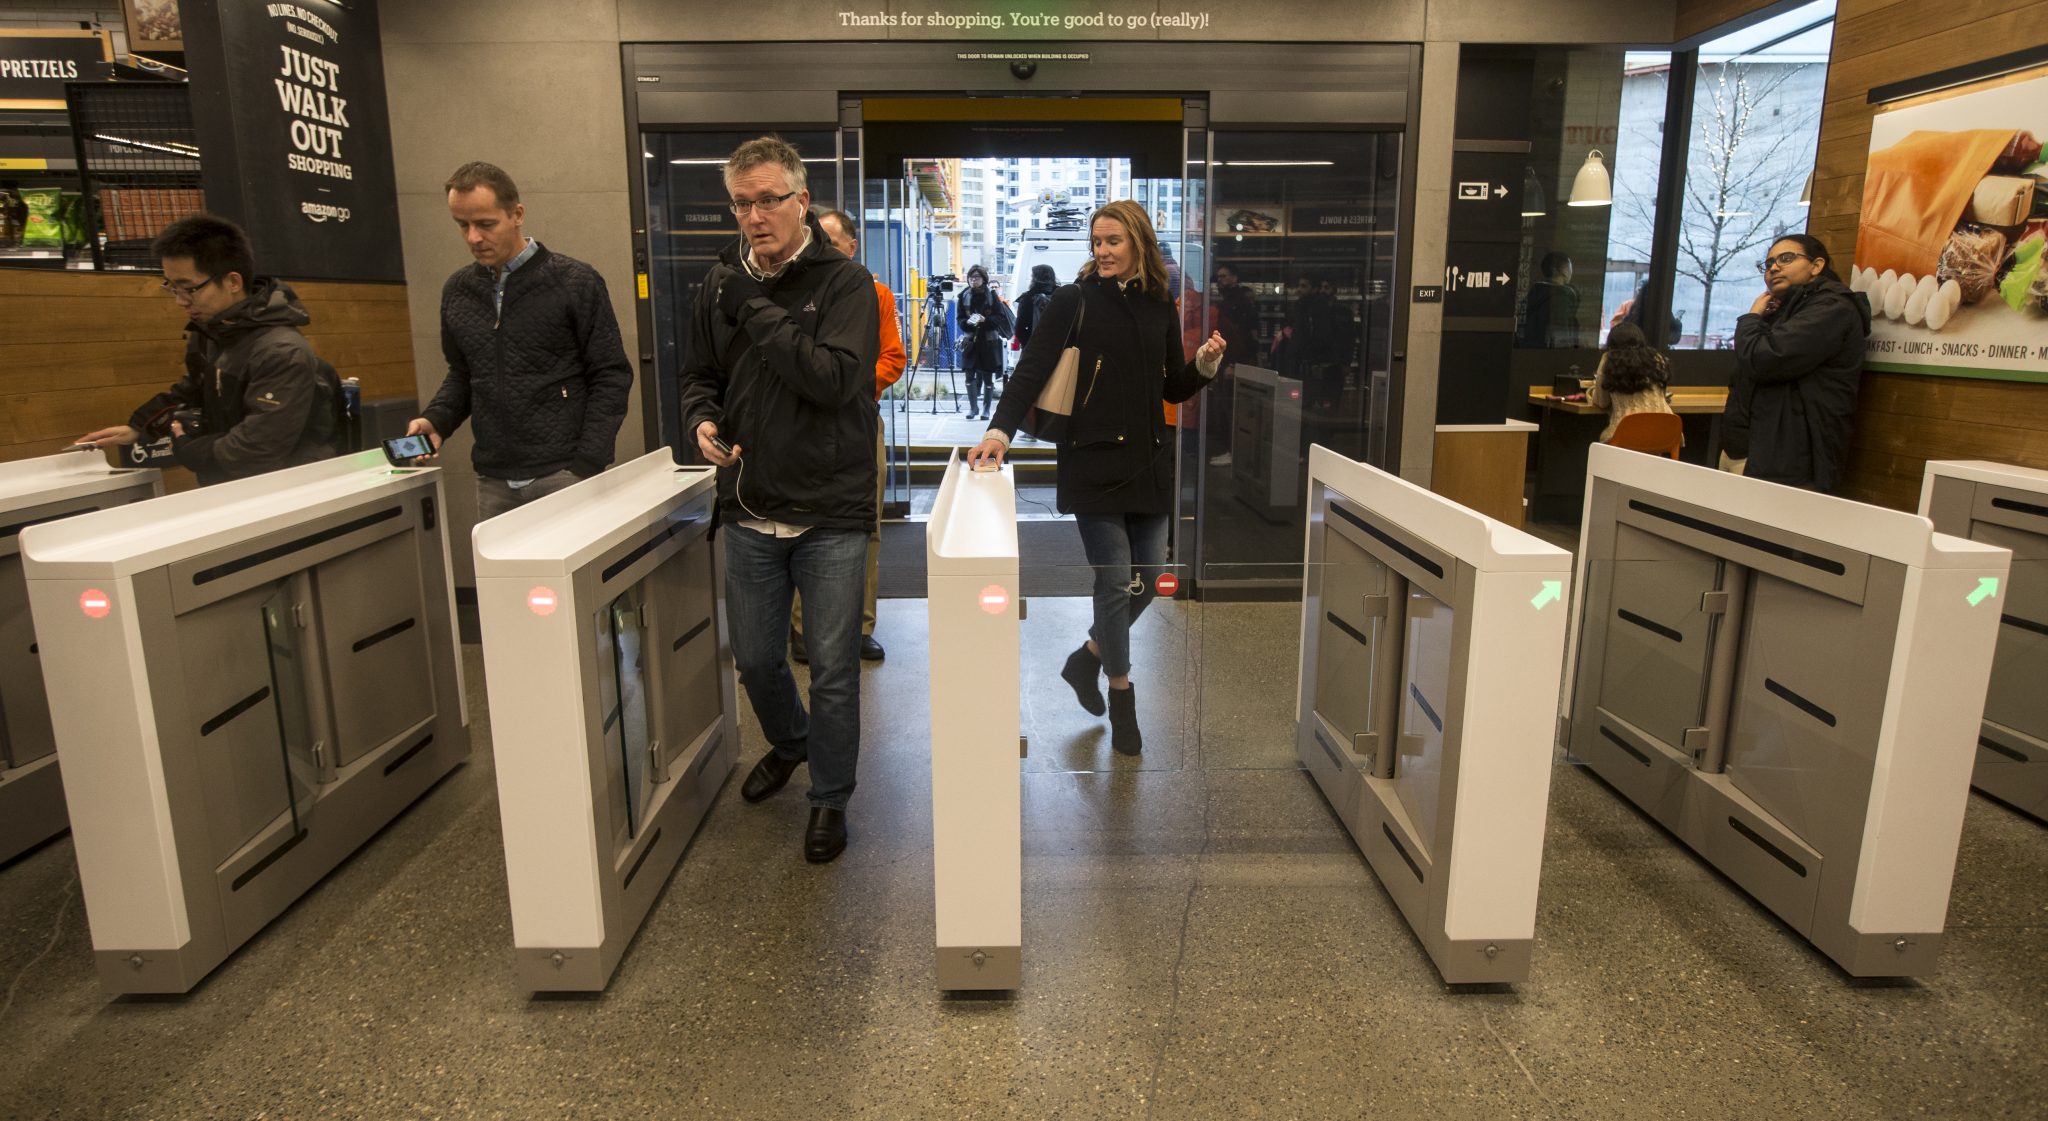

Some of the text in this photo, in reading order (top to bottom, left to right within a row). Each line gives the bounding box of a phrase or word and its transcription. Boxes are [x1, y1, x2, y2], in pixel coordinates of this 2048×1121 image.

[267, 4, 278, 18] NO
[296, 6, 307, 21] NO
[839, 11, 1210, 30] Thanks for shopping. You're good to go (really)!
[0, 59, 78, 78] PRETZELS
[280, 45, 340, 92] JUST
[274, 78, 350, 128] WALK
[290, 119, 343, 159] OUT
[287, 153, 353, 180] SHOPPING
[1419, 289, 1436, 298] EXIT
[1903, 341, 1933, 355] LUNCH
[1941, 343, 1979, 357] SNACKS
[1988, 344, 2028, 360] DINNER
